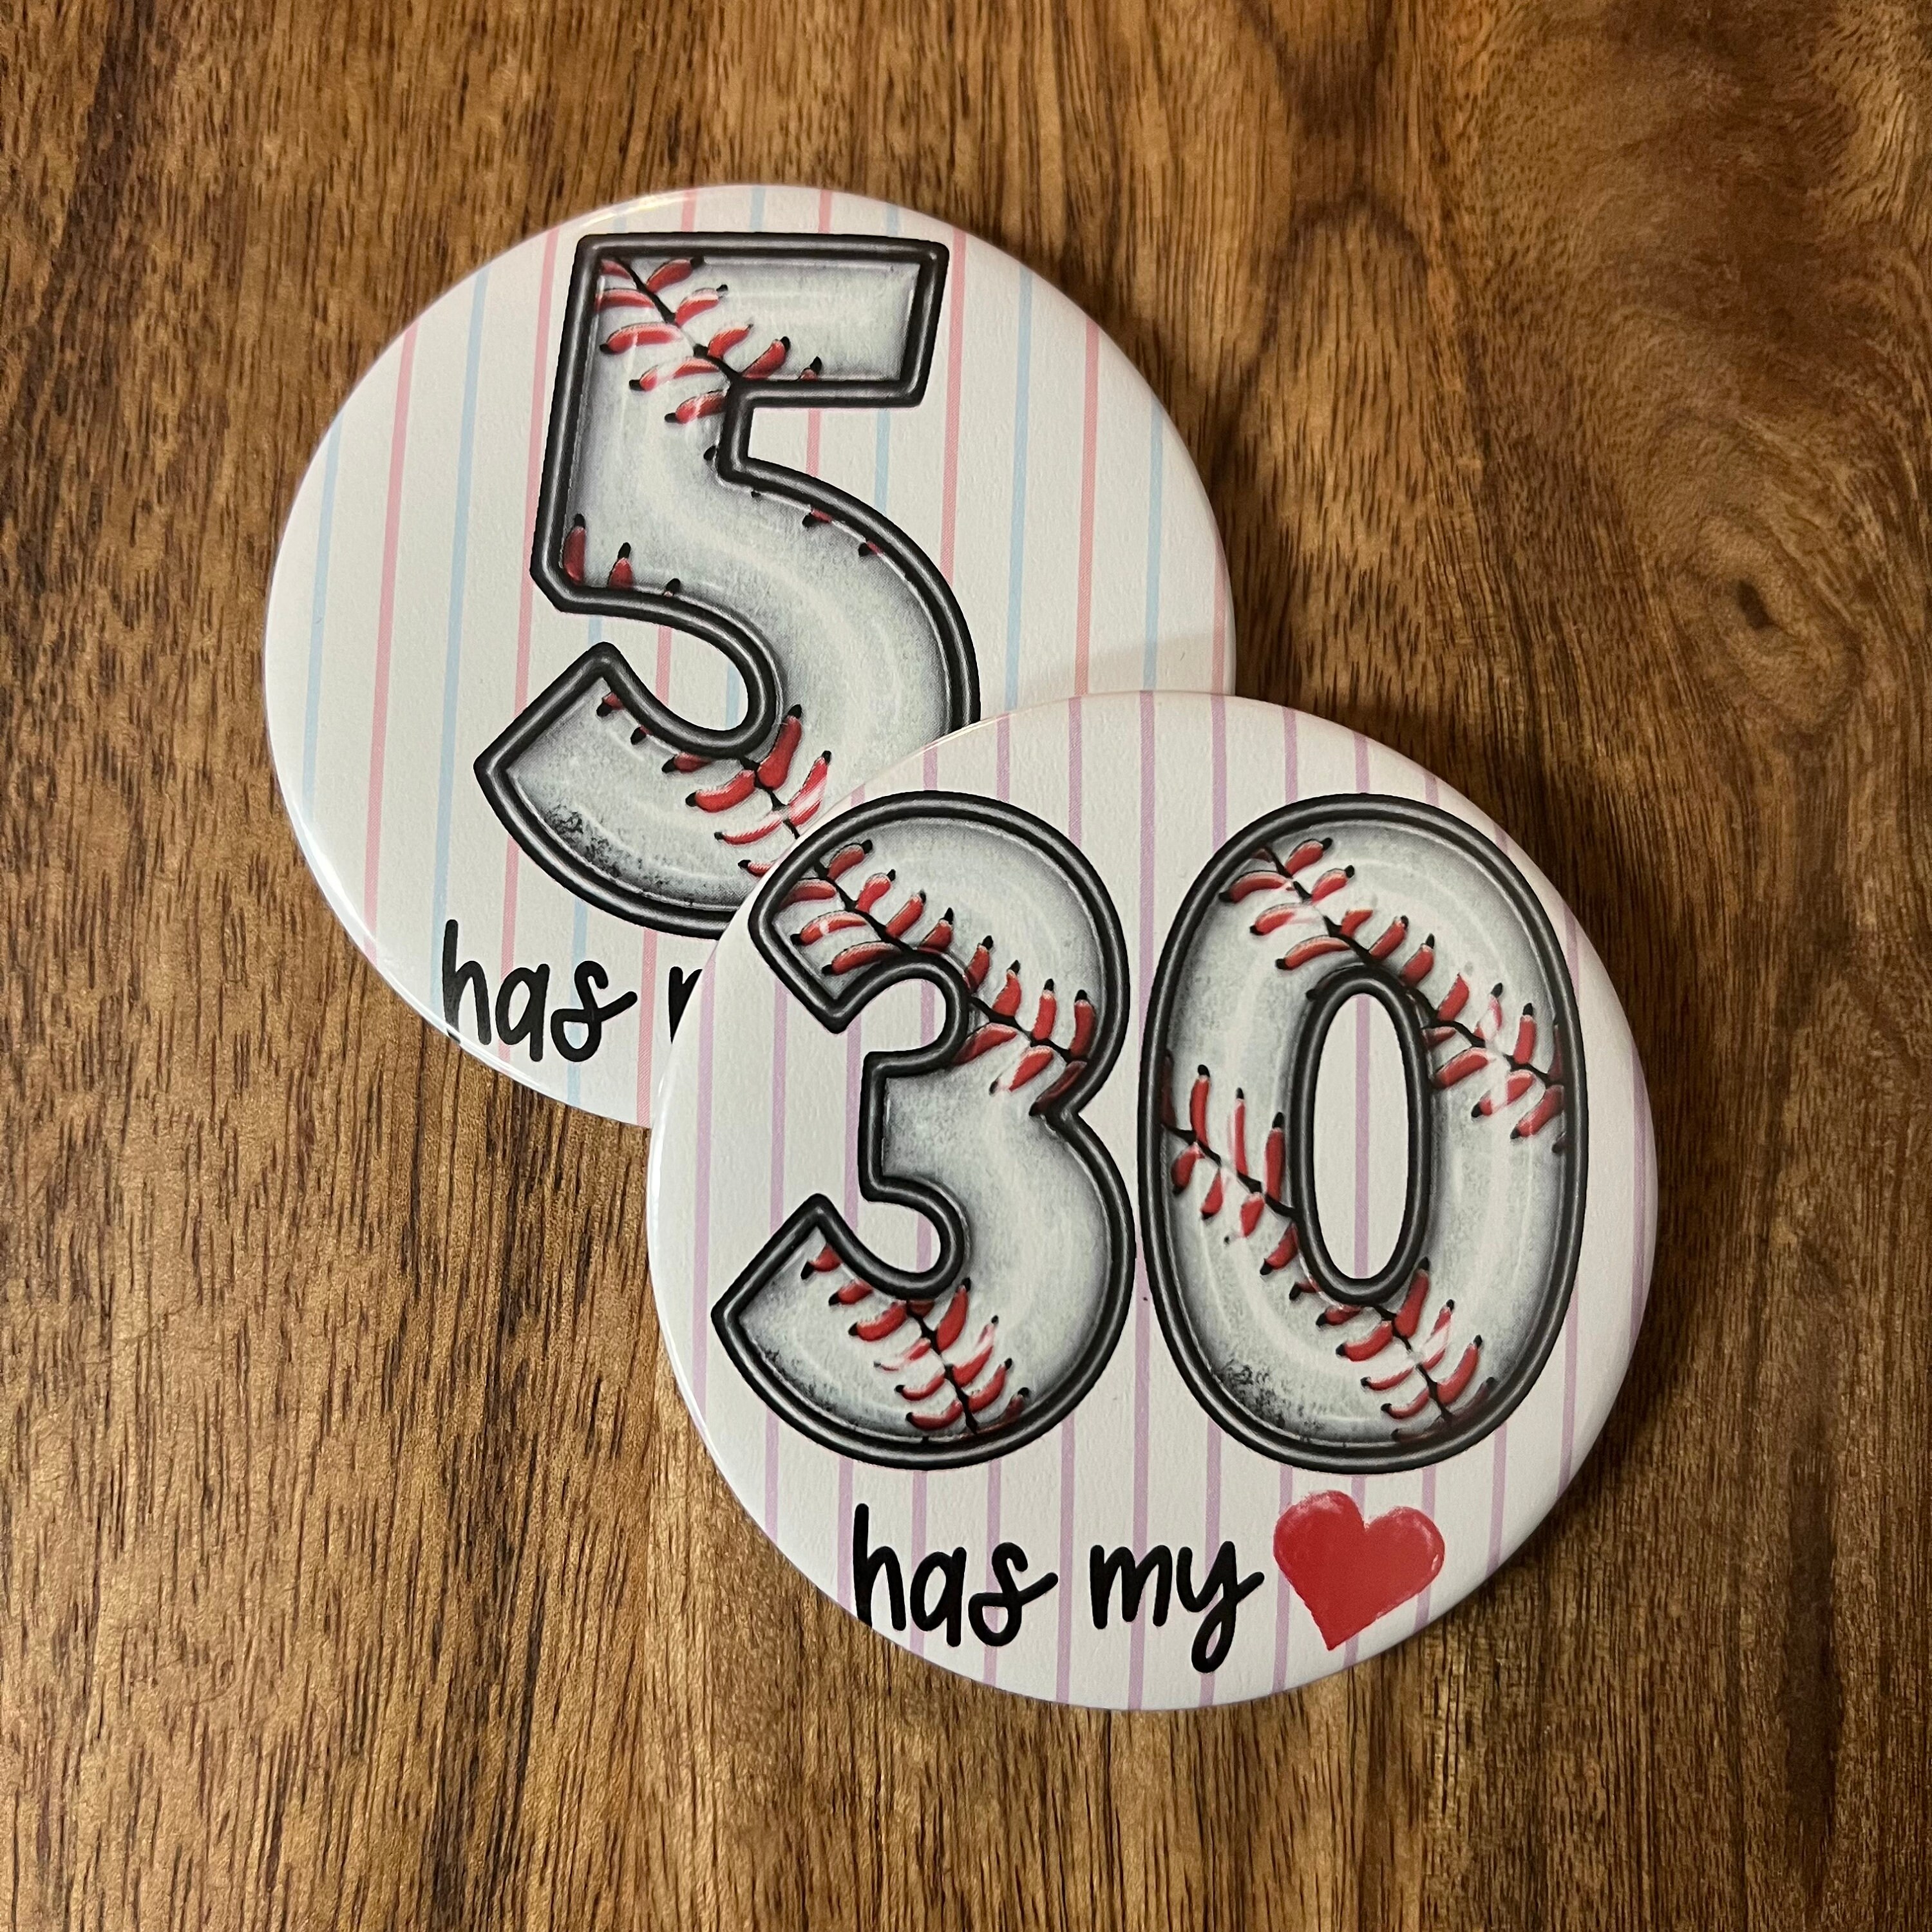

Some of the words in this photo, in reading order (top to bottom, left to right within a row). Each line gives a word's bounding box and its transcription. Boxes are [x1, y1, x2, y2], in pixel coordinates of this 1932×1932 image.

[473, 232, 981, 940] 5
[442, 919, 638, 1063] has
[711, 790, 1589, 1475] 30
[853, 1503, 1059, 1647] has
[1089, 1540, 1265, 1674] my
